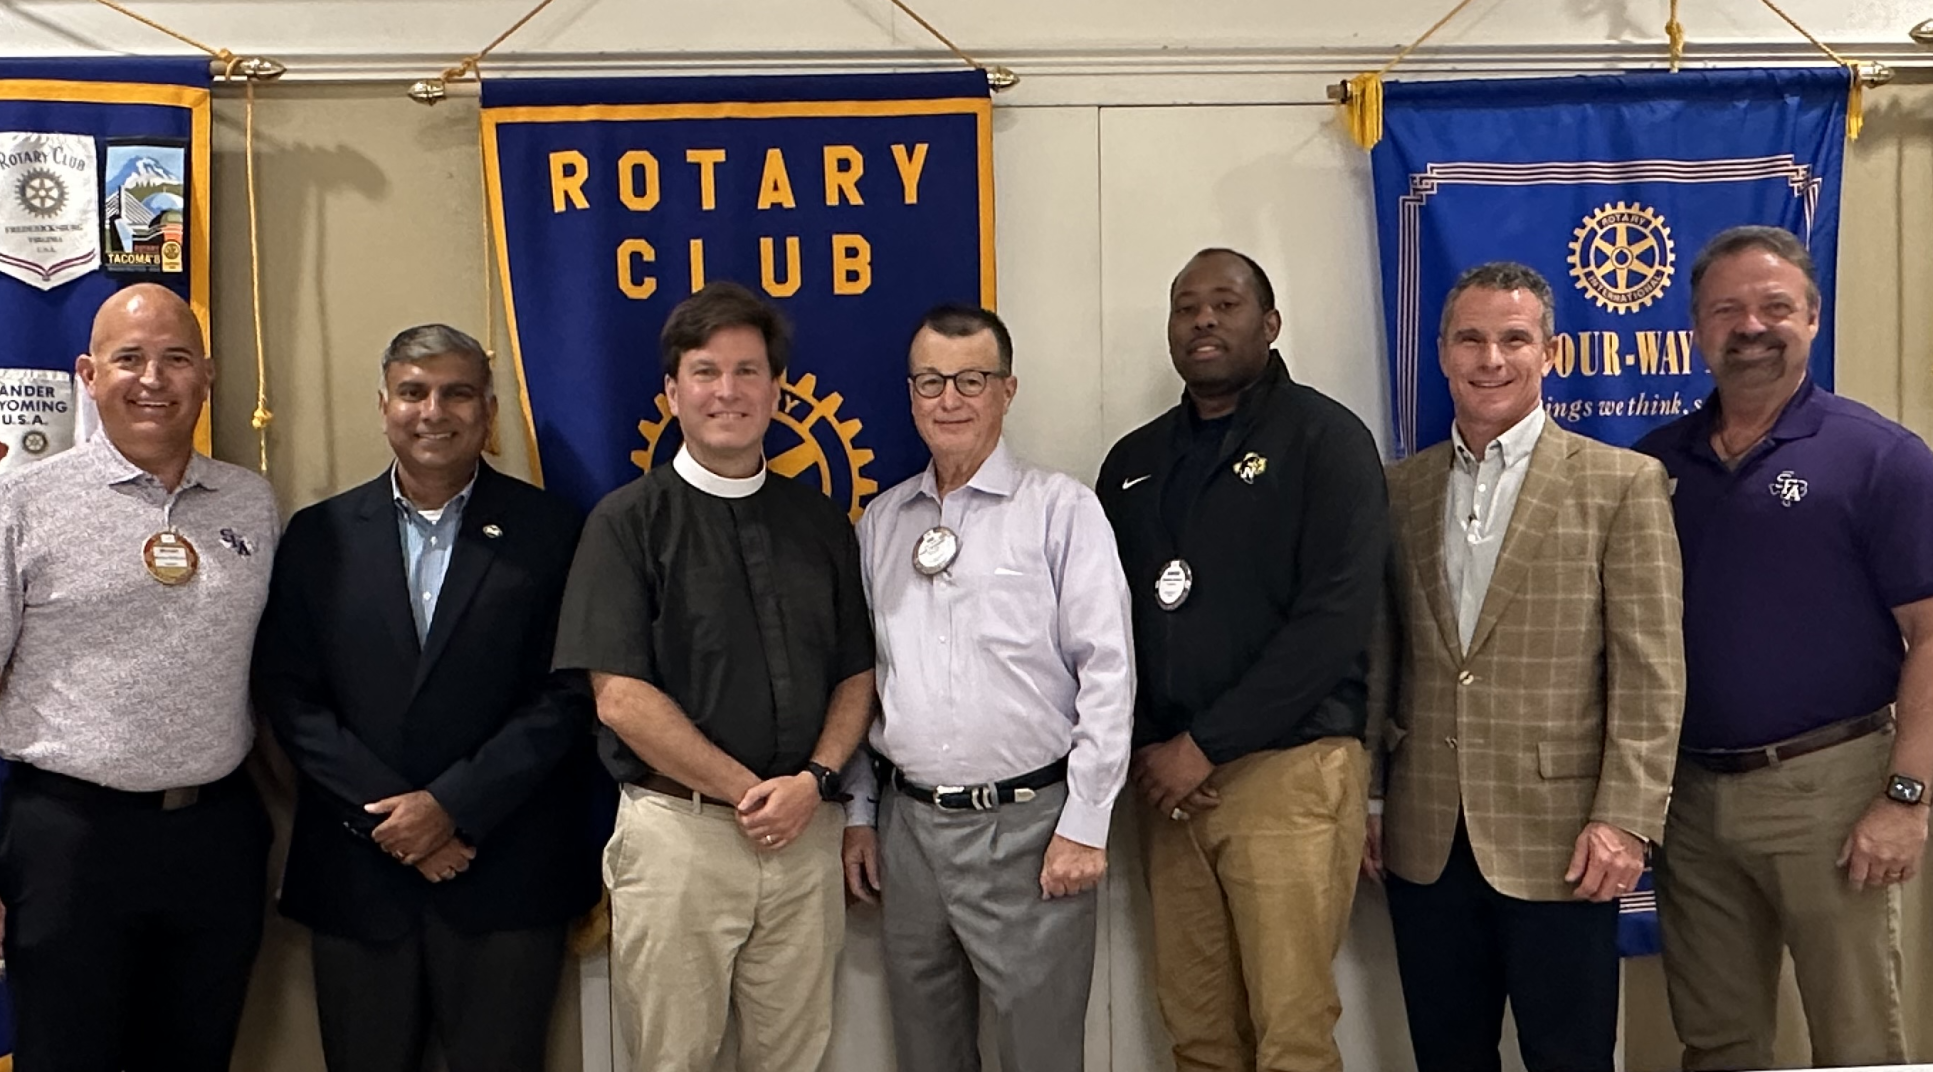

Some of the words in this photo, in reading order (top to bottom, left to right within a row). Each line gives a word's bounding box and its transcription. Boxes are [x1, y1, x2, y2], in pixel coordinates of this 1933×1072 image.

[0, 150, 47, 170] ROTARY
[53, 146, 86, 171] CLUB
[548, 143, 930, 213] ROTARY
[1602, 214, 1646, 226] ROTARY
[1553, 331, 1695, 378] OUR-WAY
[0, 385, 55, 398] ANDER
[0, 400, 68, 413] YOMING
[1545, 396, 1593, 422] ings
[1599, 402, 1624, 416] we
